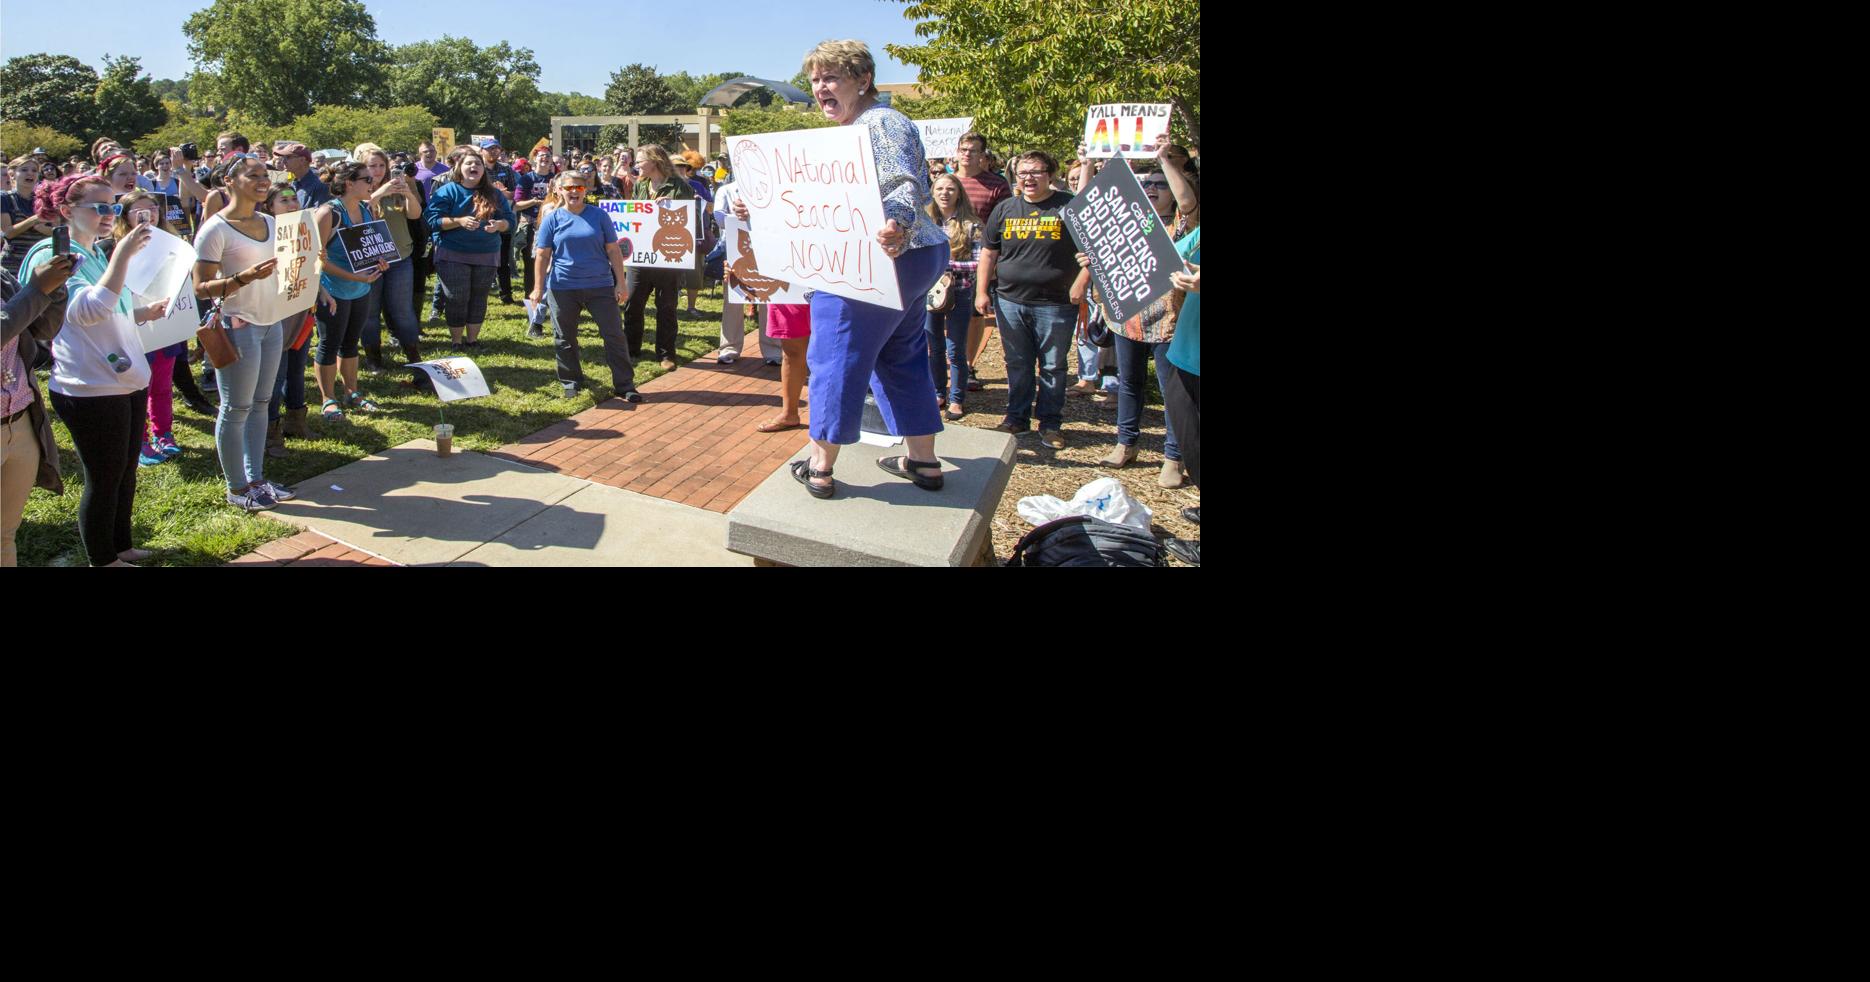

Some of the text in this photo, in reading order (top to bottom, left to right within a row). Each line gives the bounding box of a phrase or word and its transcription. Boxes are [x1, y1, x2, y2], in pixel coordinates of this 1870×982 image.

[1121, 105, 1167, 117] MEANS
[925, 137, 958, 147] Searc
[1089, 117, 1155, 152] ALL
[600, 202, 654, 214] HATERS
[781, 190, 868, 236] Search
[277, 224, 294, 241] SAY
[360, 233, 384, 247] SAY NO
[1003, 230, 1061, 240] OWLS
[1105, 186, 1157, 278] SAM OLENS:
[1086, 186, 1151, 302] BAD FOR LGBTQ
[350, 249, 363, 261] TO
[362, 245, 380, 258] SAM
[632, 251, 657, 265] LEAD
[1078, 206, 1133, 301] BAD FOR KSU
